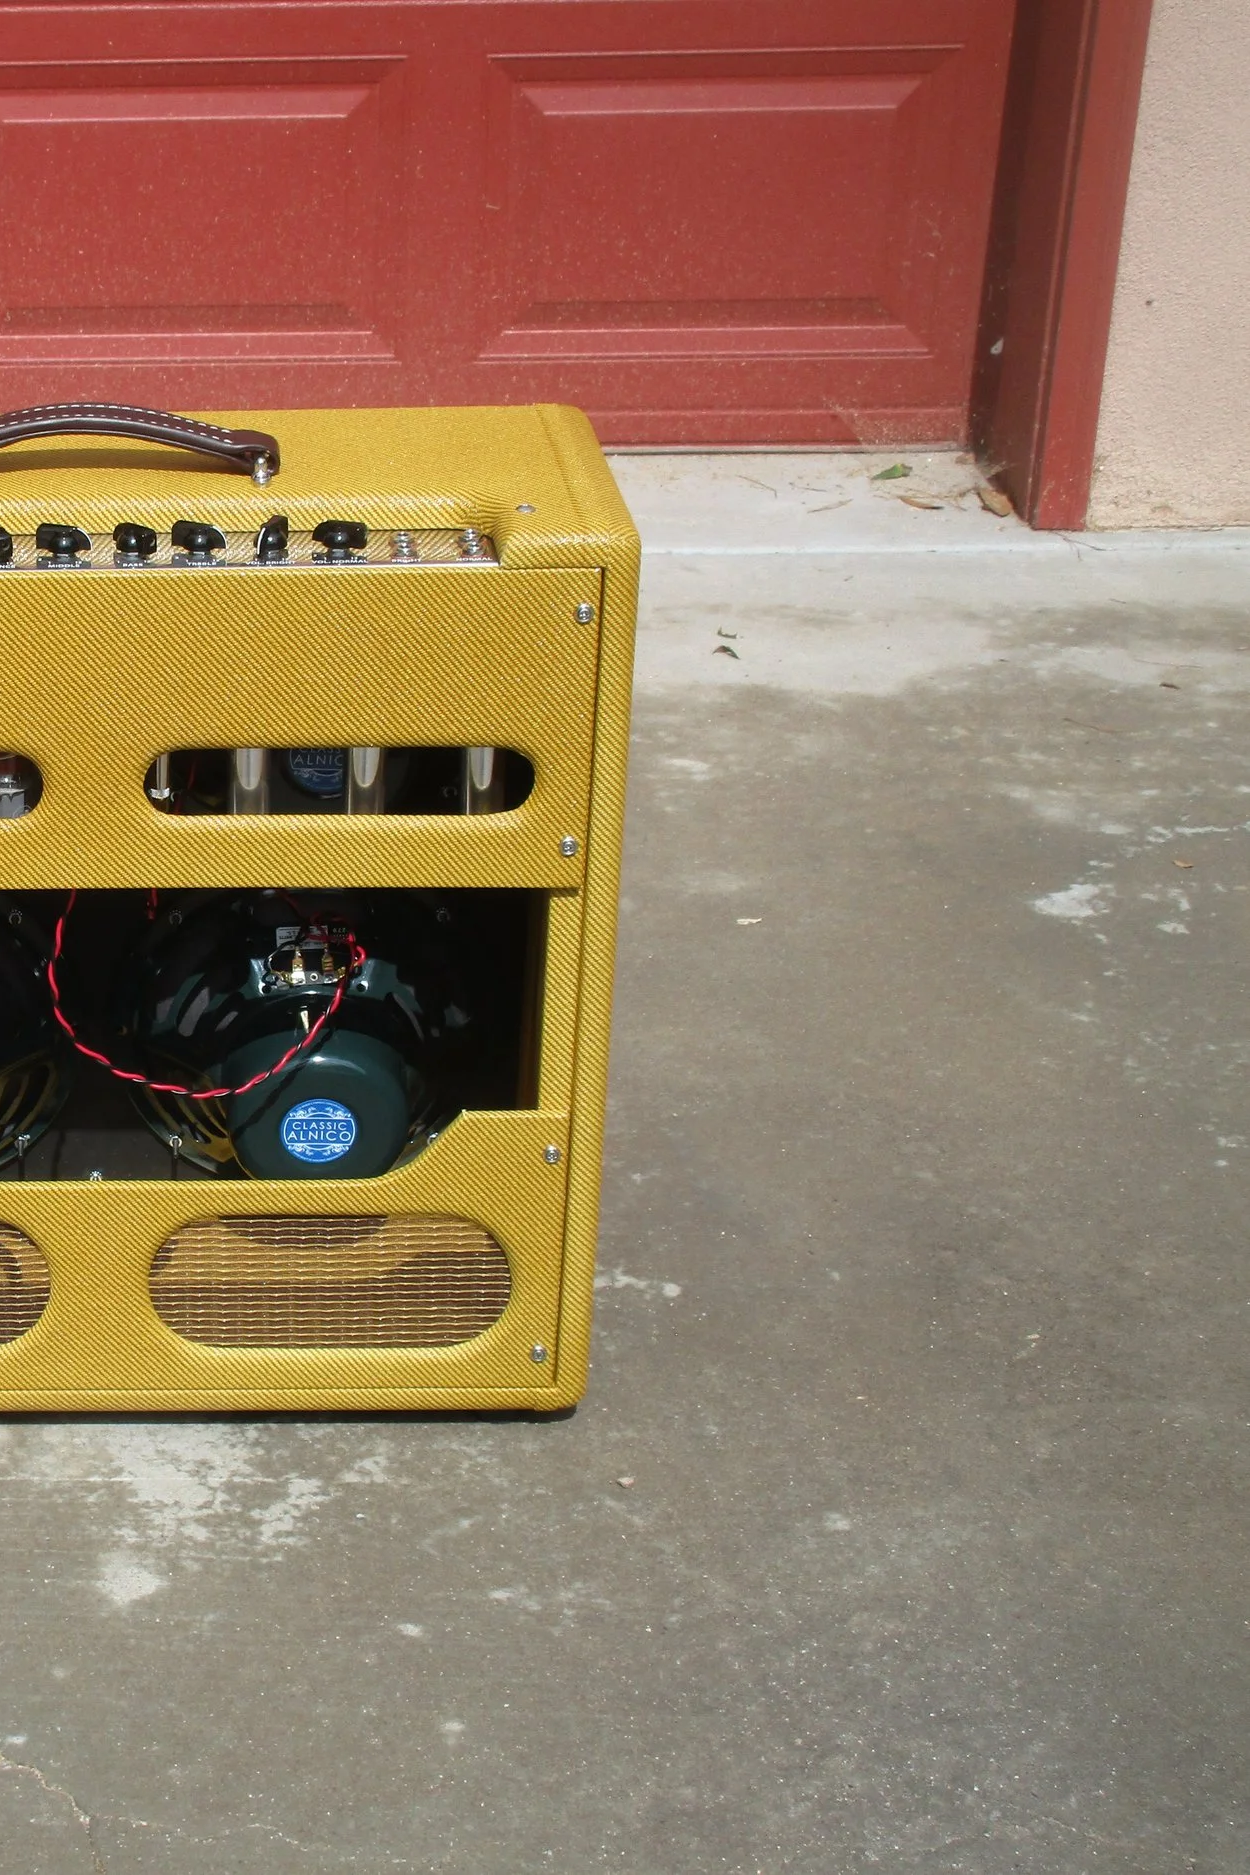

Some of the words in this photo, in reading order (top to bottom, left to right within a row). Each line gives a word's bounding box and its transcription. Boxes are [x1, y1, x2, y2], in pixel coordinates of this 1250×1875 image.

[293, 754, 344, 767] ALNIC
[292, 1121, 347, 1131] CLASSIC
[287, 1130, 352, 1142] ALNICO
